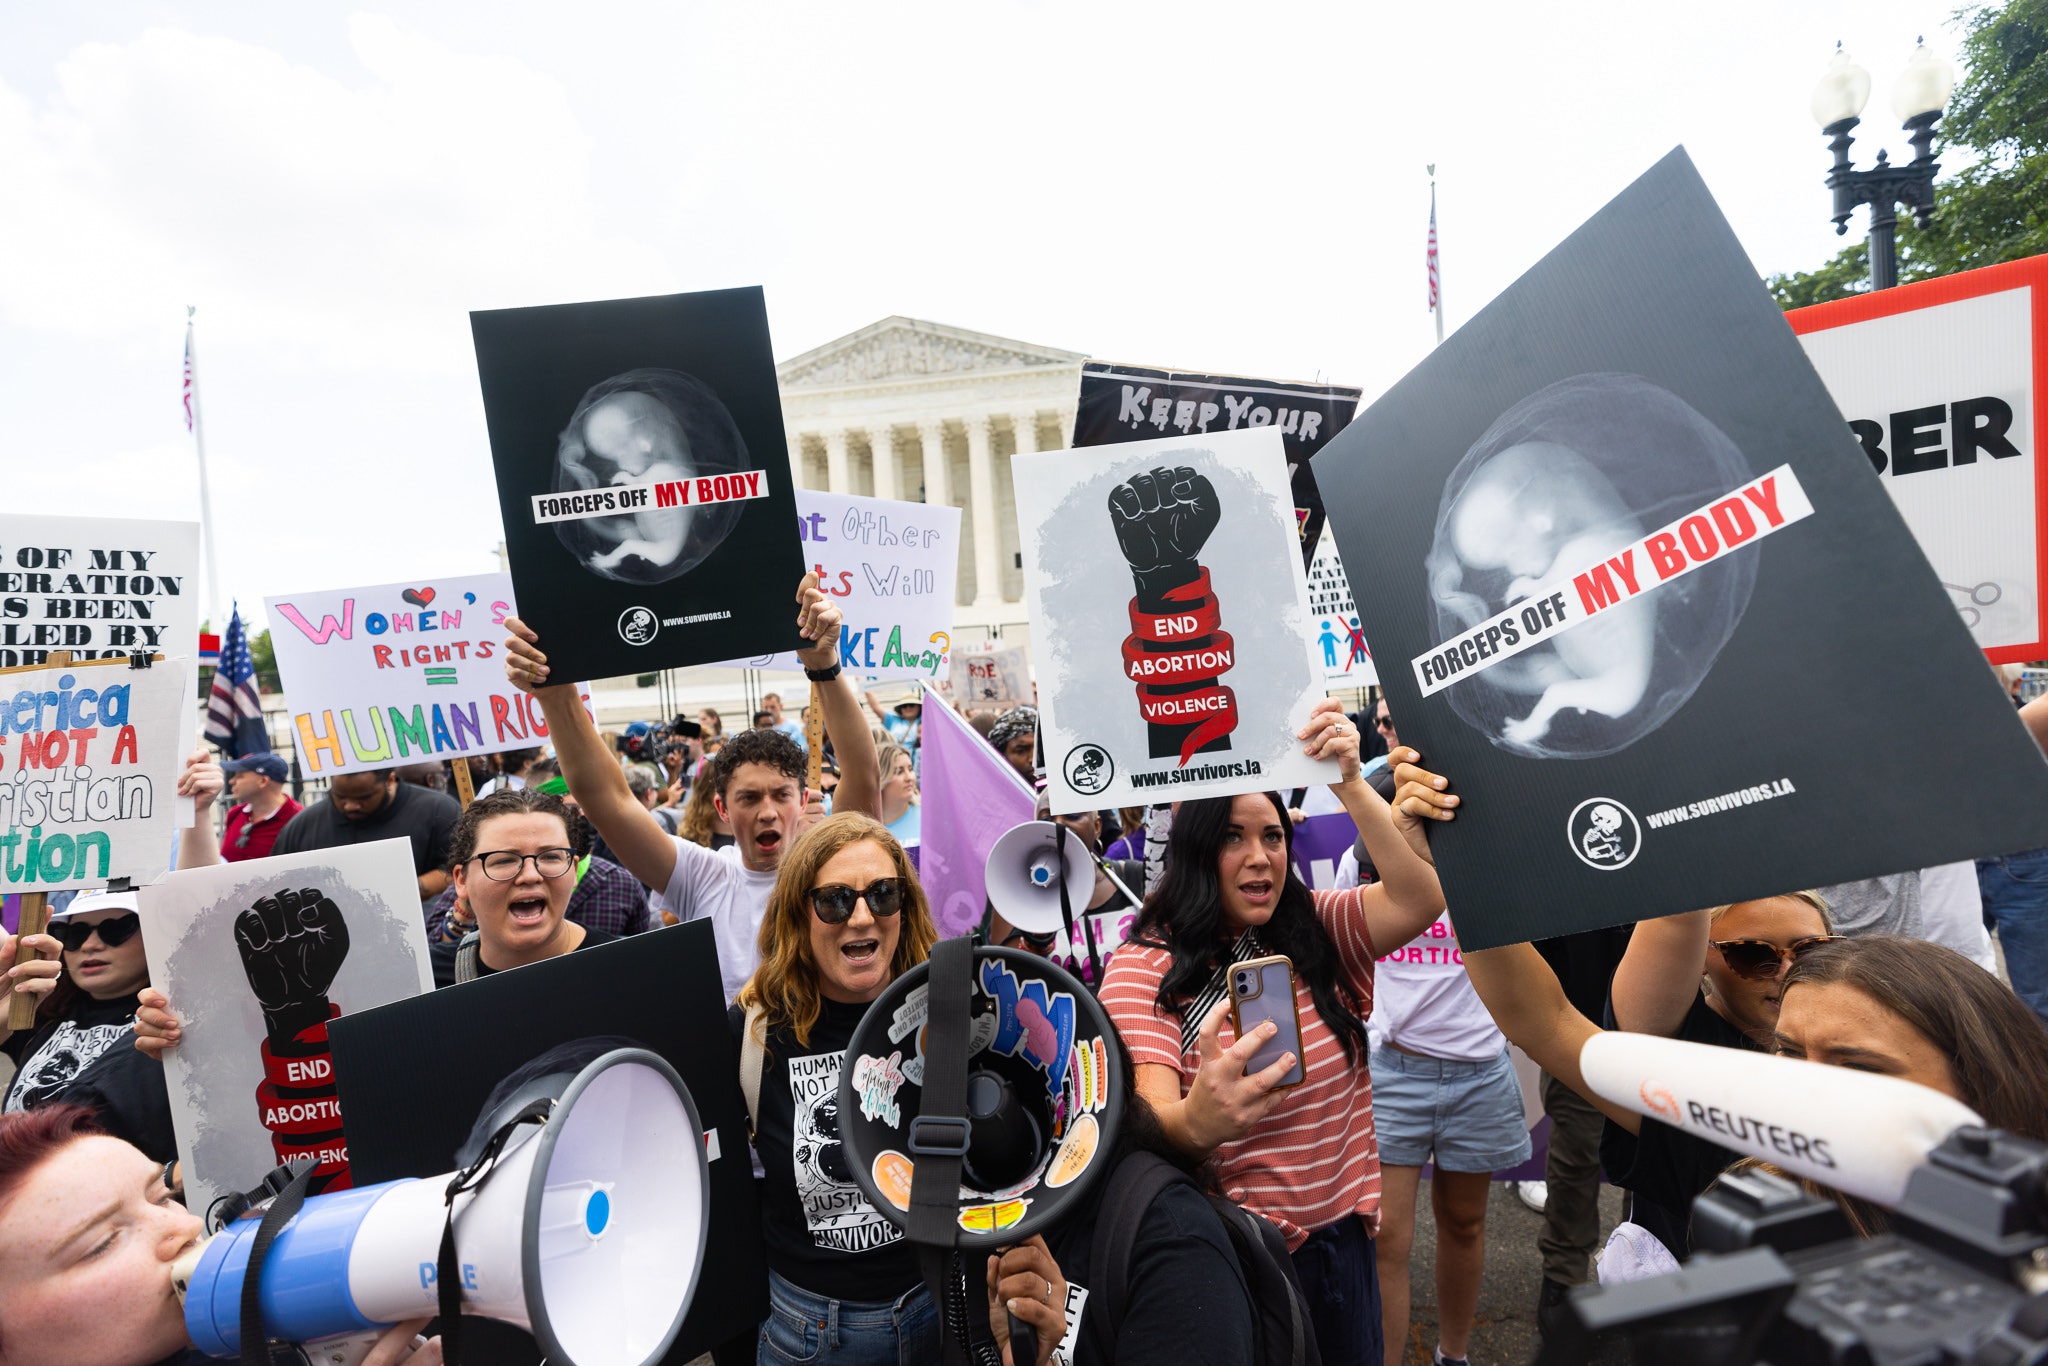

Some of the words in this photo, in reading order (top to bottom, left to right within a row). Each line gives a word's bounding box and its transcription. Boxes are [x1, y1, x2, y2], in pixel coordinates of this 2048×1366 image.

[1118, 385, 1220, 434] KEEP
[1224, 394, 1322, 441] YOUR
[538, 492, 615, 518] FORCEPS
[619, 488, 648, 508] OFF
[655, 480, 690, 508] MY
[696, 472, 760, 503] BODY
[842, 507, 940, 548] Other
[16, 547, 72, 569] OF
[88, 550, 157, 571] MY
[0, 572, 183, 596] ERATION
[862, 563, 933, 596] Will
[1420, 617, 1521, 687] FORCEPS
[1522, 591, 1567, 636] OFF
[1572, 549, 1641, 616] MY
[1644, 476, 1786, 580] BODY
[0, 597, 28, 618] S
[44, 600, 155, 619] BEEN
[662, 610, 732, 628] WWW.SURVIVORS.LA
[0, 624, 92, 645] LED
[107, 625, 169, 646] BY
[1154, 616, 1198, 637] END
[373, 641, 496, 669] RIGHTS
[882, 624, 950, 676] Away?
[1130, 650, 1232, 677] ABORTION
[1145, 695, 1228, 717] VIOLENCE
[19, 728, 98, 769] NOT
[111, 724, 138, 765] A
[295, 701, 484, 772] HUMAN
[1130, 759, 1262, 789] www.survivors.la
[1646, 777, 1796, 829] WWW.SURVIVORS.LA
[0, 826, 111, 883] tion
[287, 1059, 331, 1082] END
[793, 1075, 830, 1104] NOT
[1688, 1101, 1837, 1169] REUTERS
[419, 1262, 478, 1291] PE
